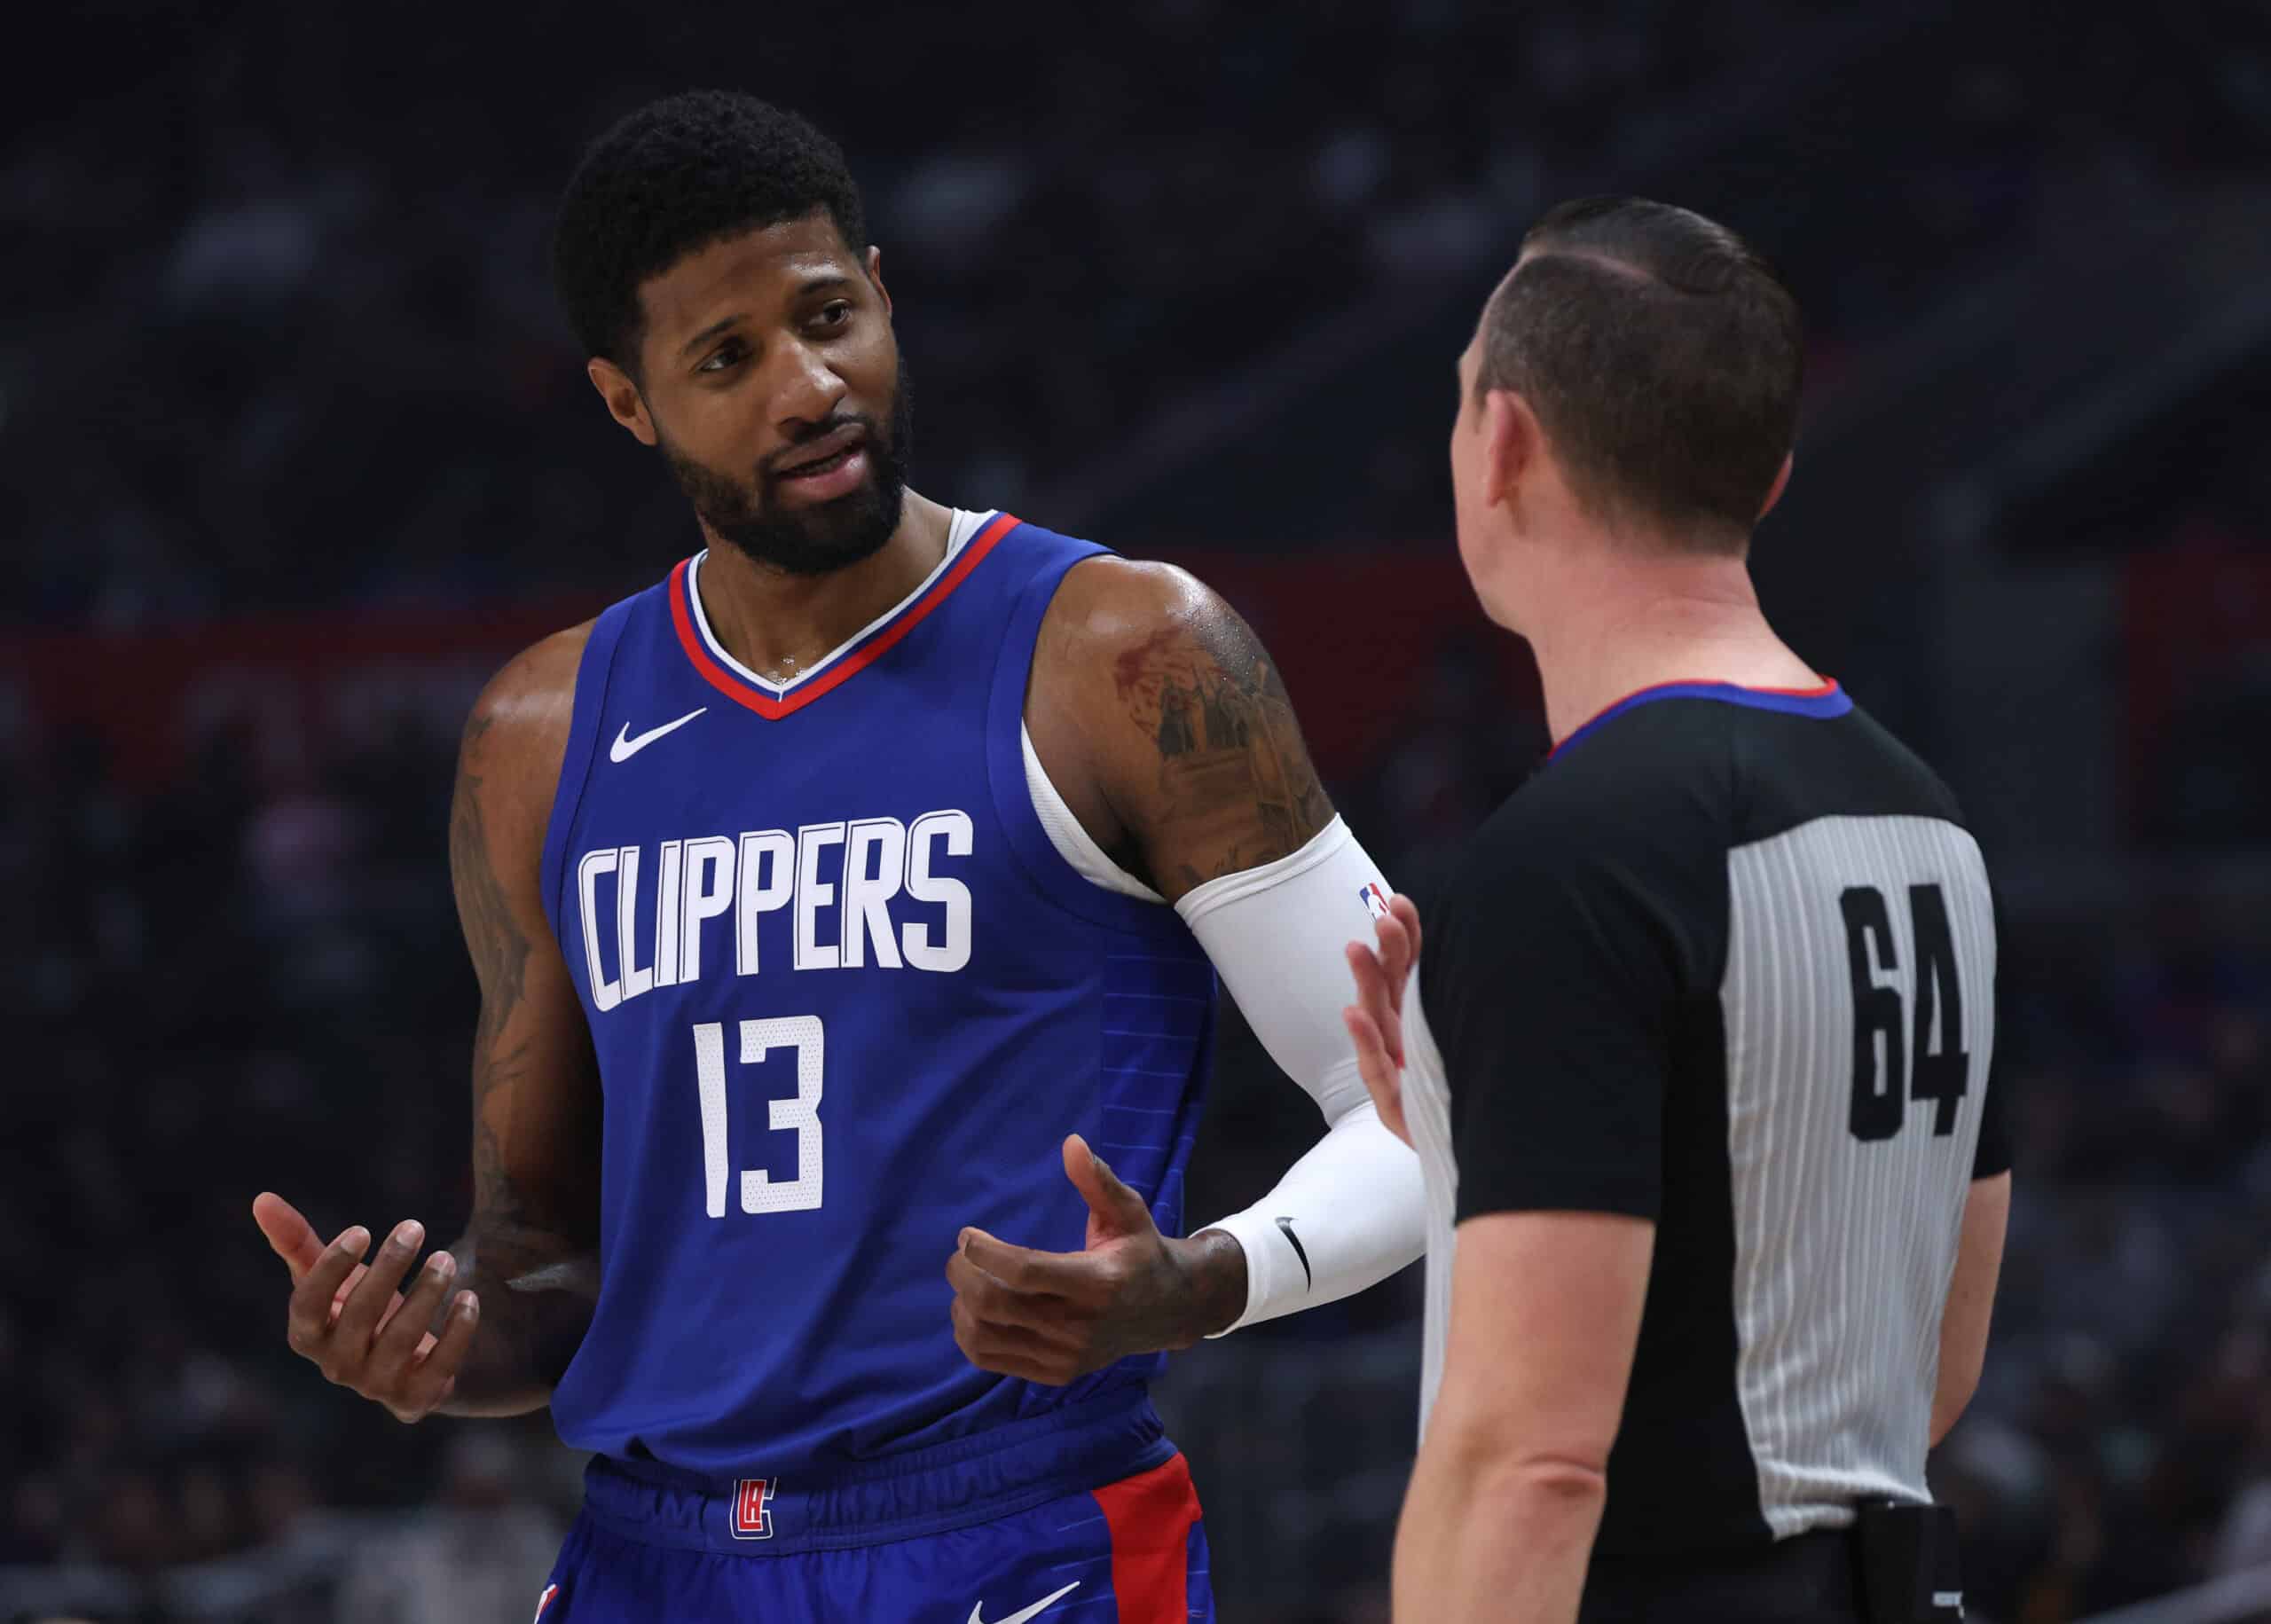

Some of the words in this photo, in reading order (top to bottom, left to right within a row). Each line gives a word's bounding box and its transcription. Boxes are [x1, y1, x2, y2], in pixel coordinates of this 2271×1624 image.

[578, 808, 974, 1013] CLIPPERS
[1839, 883, 1969, 1142] 64
[692, 1015, 824, 1219] 13
